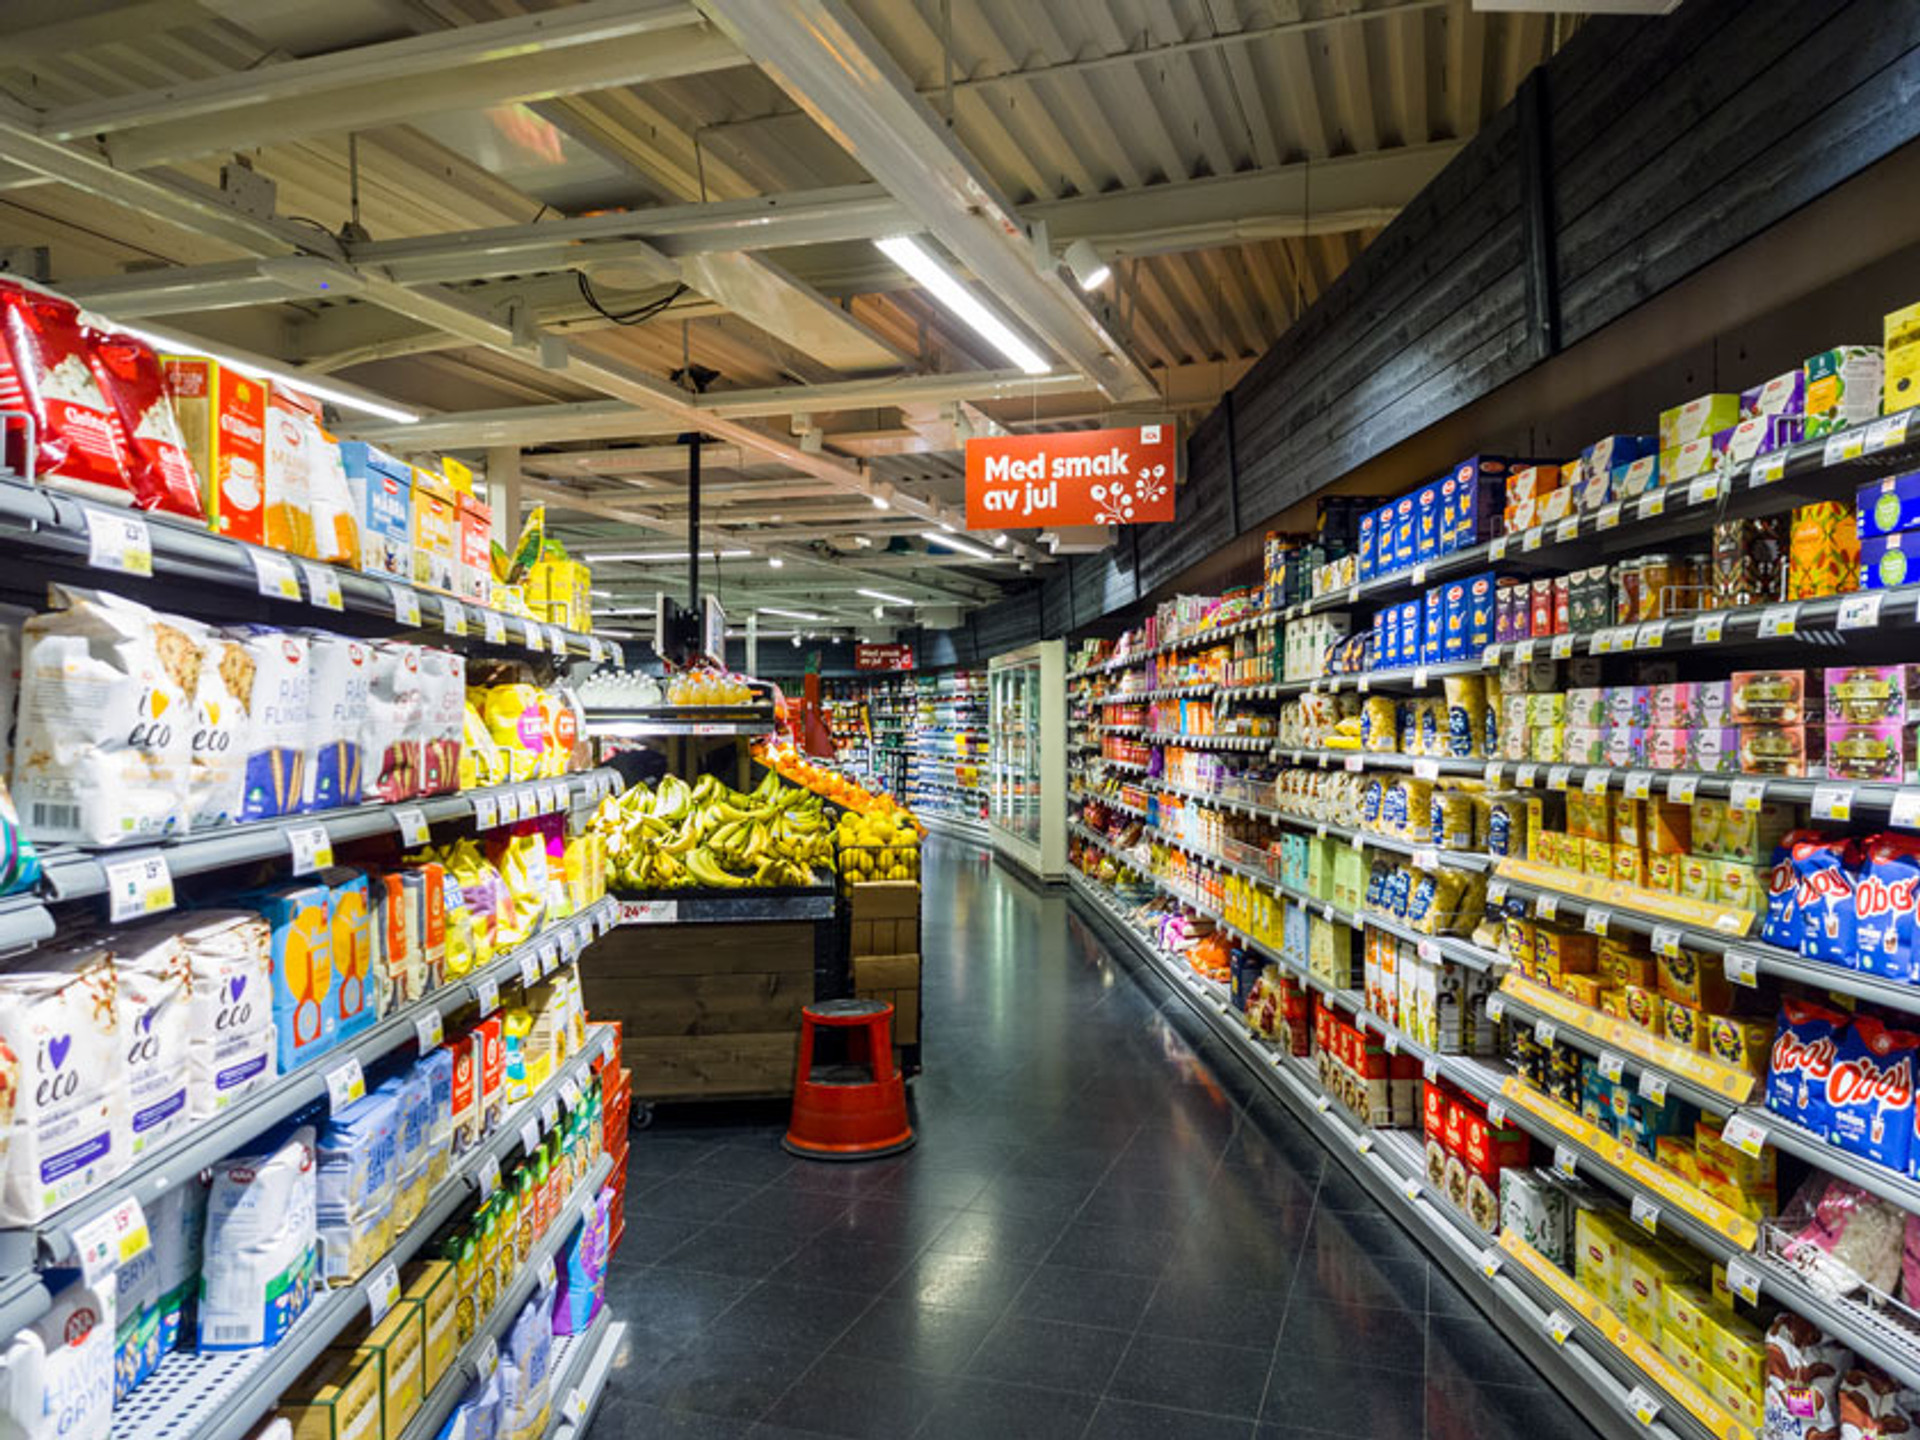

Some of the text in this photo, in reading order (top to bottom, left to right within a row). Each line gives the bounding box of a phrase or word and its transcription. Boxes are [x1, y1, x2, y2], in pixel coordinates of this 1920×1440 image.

[984, 447, 1129, 482] Med smak
[983, 481, 1057, 516] av jul
[128, 722, 171, 749] eco
[191, 729, 230, 752] eco
[623, 905, 639, 918] 24
[219, 977, 228, 1004] i
[215, 1003, 251, 1031] eco
[36, 1040, 46, 1073] i
[36, 1070, 80, 1107] eco
